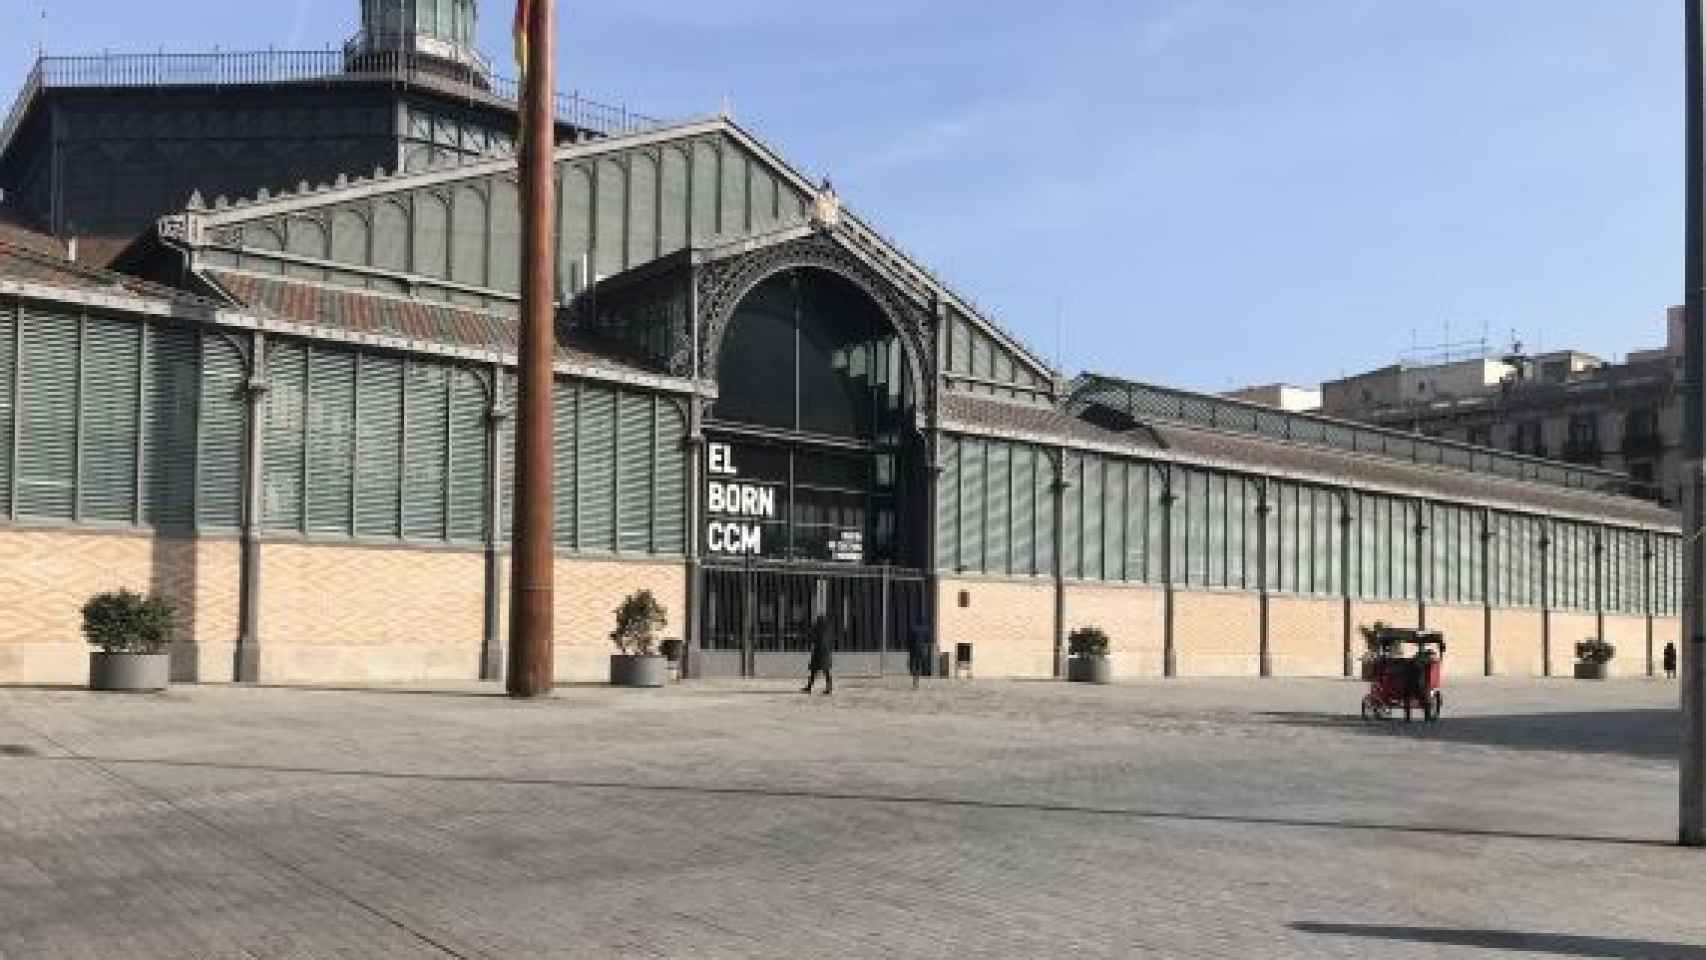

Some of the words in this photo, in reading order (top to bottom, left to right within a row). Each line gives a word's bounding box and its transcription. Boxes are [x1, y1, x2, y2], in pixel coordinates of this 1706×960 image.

[708, 442, 737, 474] EL
[708, 482, 775, 518] BORN
[708, 521, 761, 554] CCM
